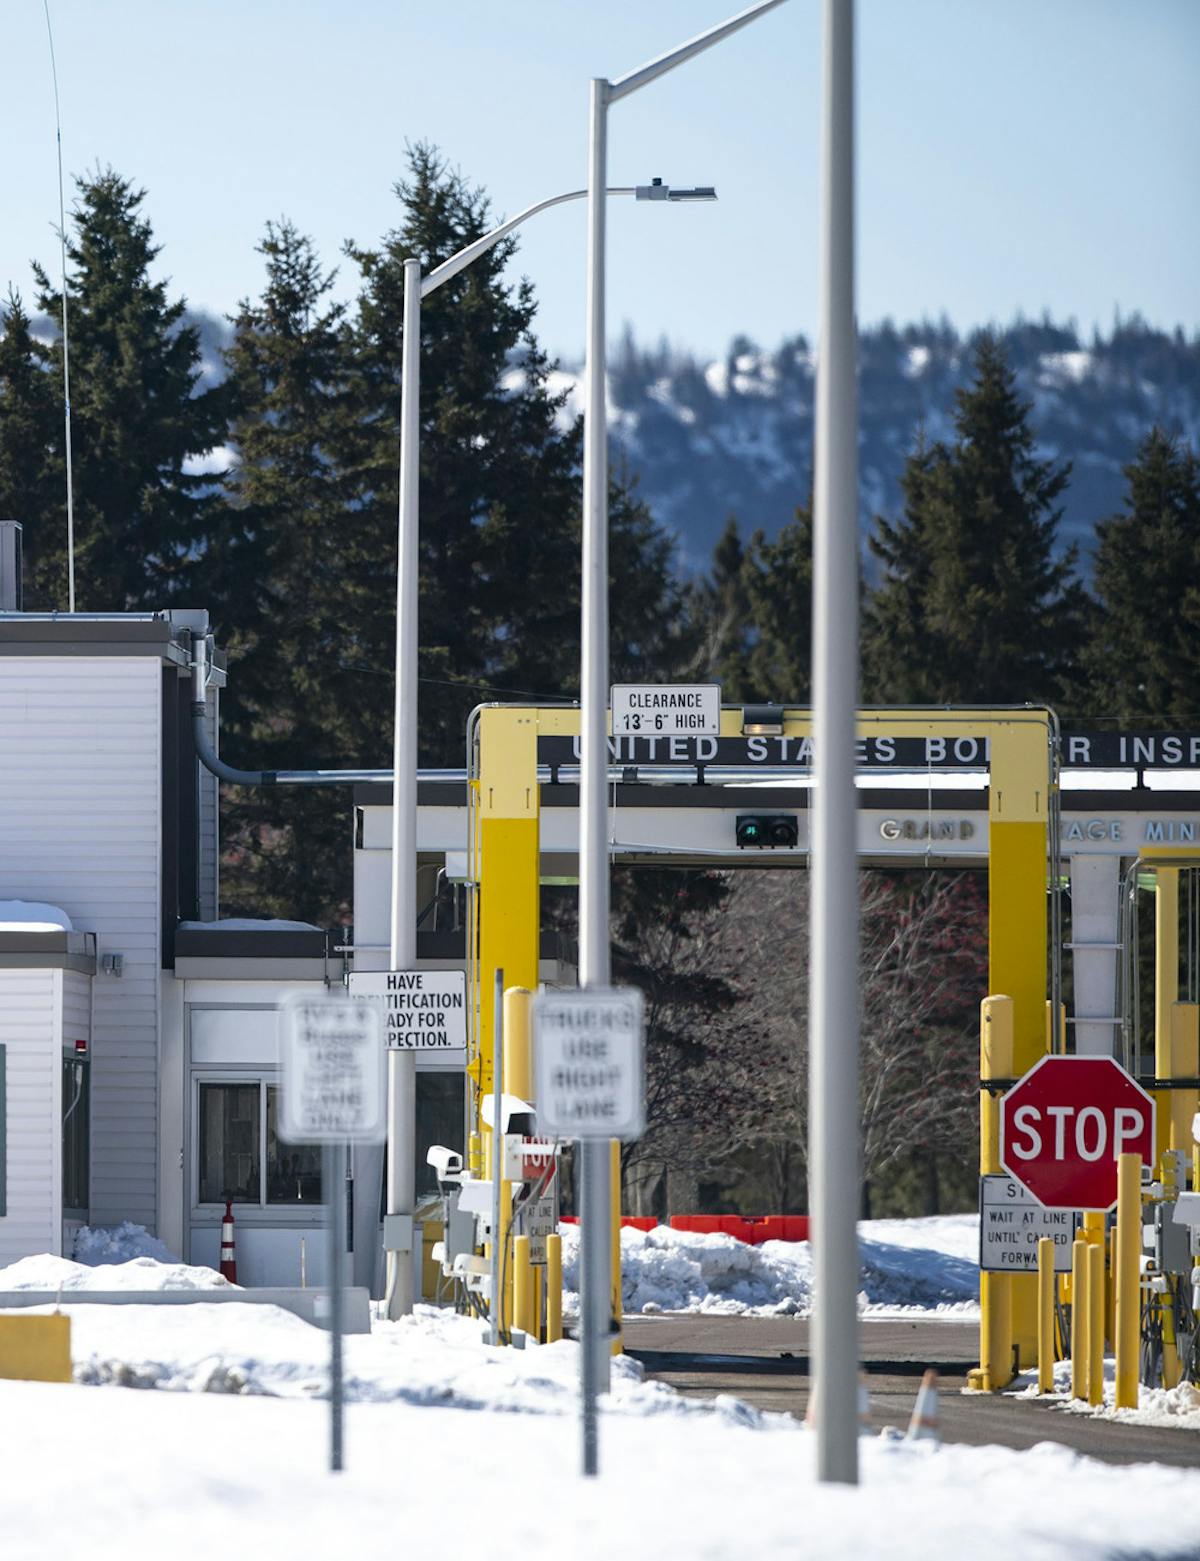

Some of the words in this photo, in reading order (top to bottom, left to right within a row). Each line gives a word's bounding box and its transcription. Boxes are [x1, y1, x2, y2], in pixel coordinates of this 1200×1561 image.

[628, 693, 702, 708] CLEARANCE
[675, 714, 705, 729] HIGH
[746, 736, 896, 762] STAES
[879, 819, 975, 841] GRAND
[387, 975, 423, 990] HAVE
[352, 993, 463, 1009] TIFICATION
[386, 1012, 414, 1028] ADY
[418, 1012, 445, 1028] FOR
[385, 1031, 452, 1048] PECTION.
[1011, 1104, 1145, 1163] STOP
[989, 1211, 1014, 1224] WAIT
[1022, 1212, 1035, 1224] AT
[1043, 1212, 1068, 1225] LINE
[1001, 1252, 1039, 1264] FORWA
